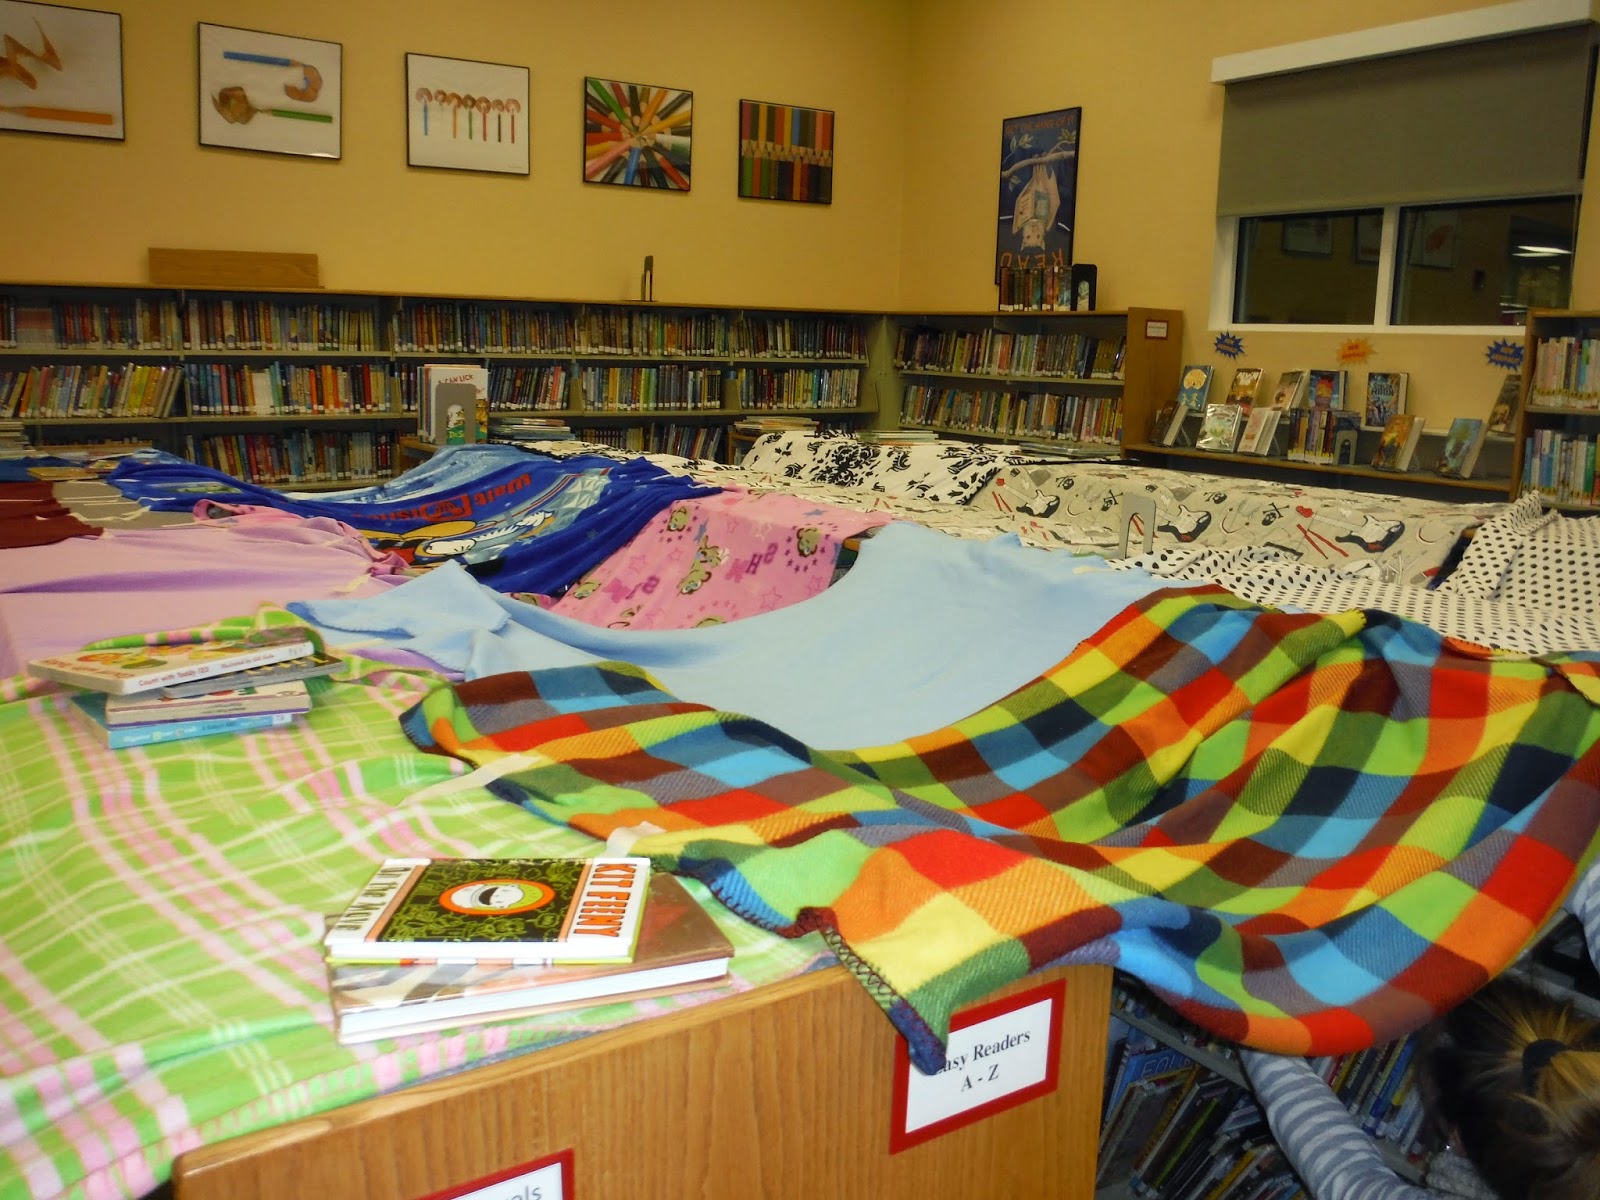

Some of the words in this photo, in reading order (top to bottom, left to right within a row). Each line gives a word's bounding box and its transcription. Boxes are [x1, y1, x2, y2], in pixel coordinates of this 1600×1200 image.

[459, 373, 474, 382] LICK
[590, 863, 637, 888] KIT
[573, 891, 631, 938] FEENY
[936, 1053, 968, 1075] asy
[972, 1030, 1032, 1062] Readers
[961, 1075, 973, 1092] A
[987, 1063, 1001, 1082] Z
